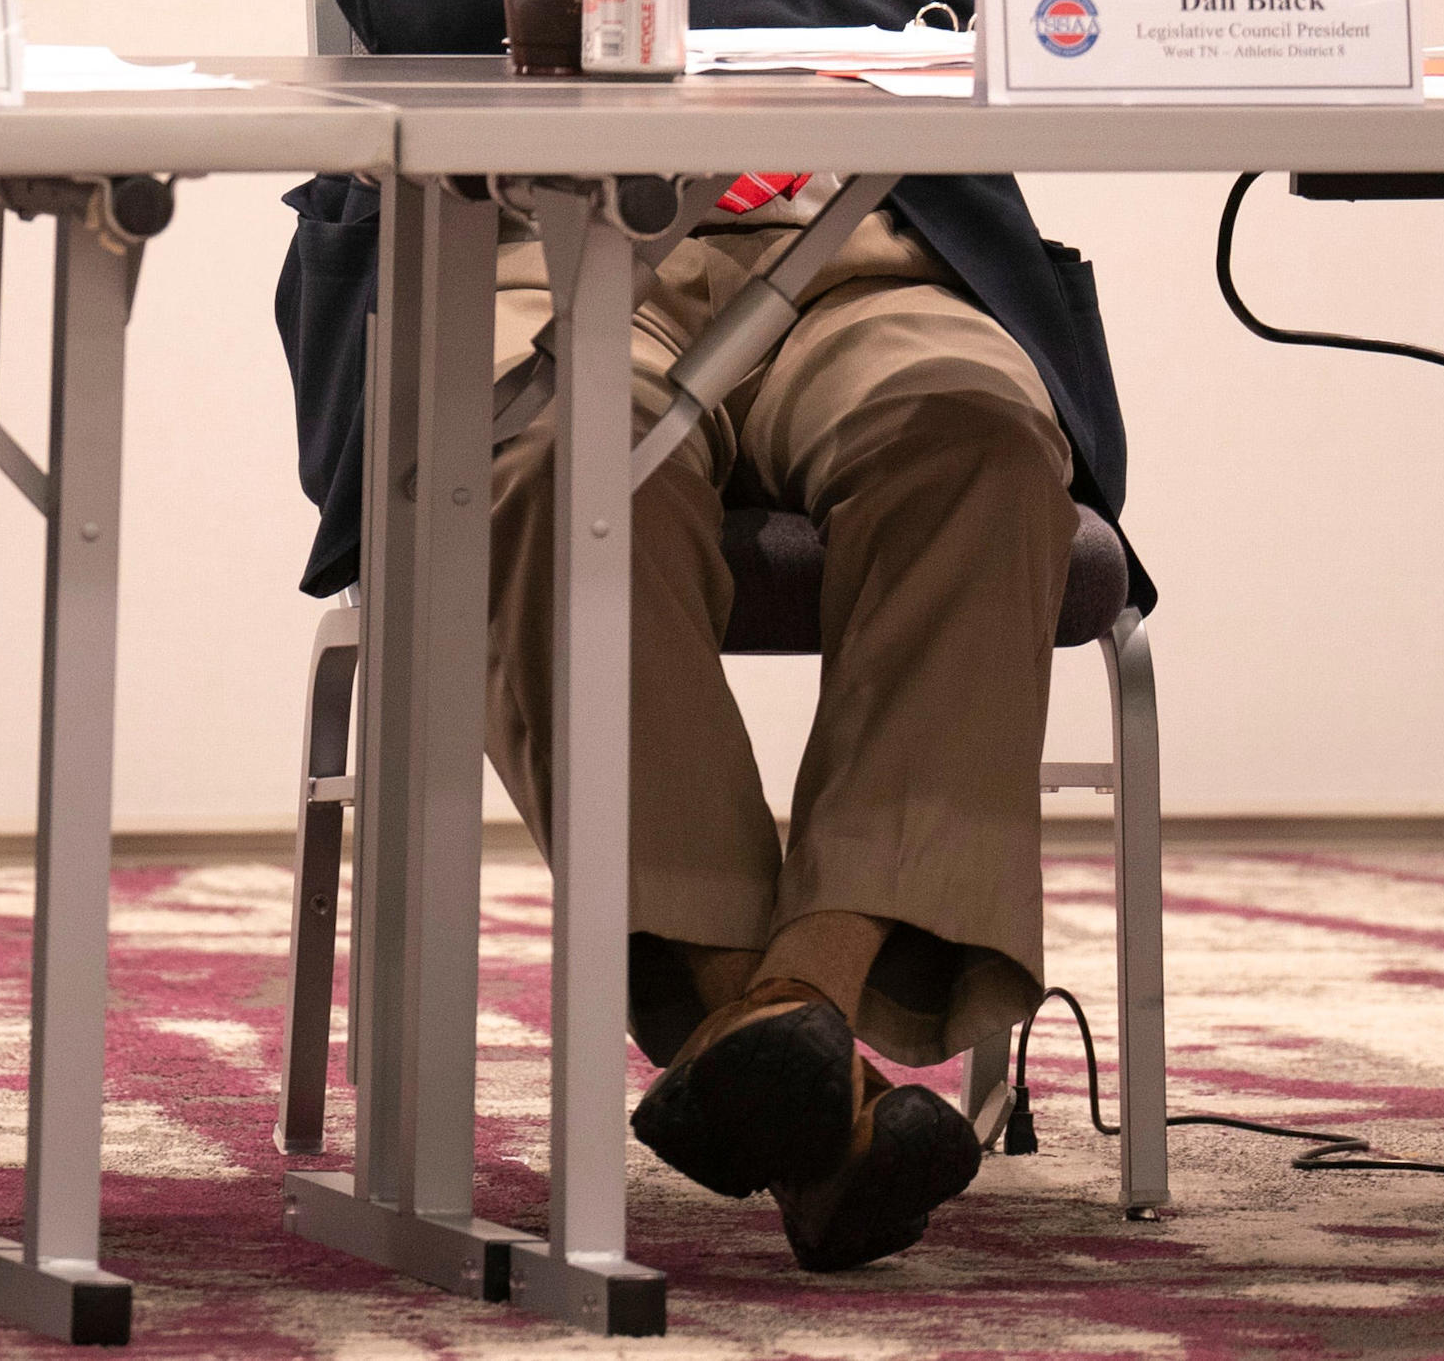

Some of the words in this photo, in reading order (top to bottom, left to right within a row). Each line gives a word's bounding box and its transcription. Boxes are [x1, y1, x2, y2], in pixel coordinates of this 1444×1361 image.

[641, 3, 653, 64] RECYCLE
[1137, 23, 1224, 42] Legislative
[1229, 22, 1291, 39] Council
[1297, 22, 1371, 39] President
[1163, 46, 1194, 58] West
[1199, 46, 1218, 58] TN
[1234, 45, 1283, 58] Athletic
[1288, 45, 1333, 58] District
